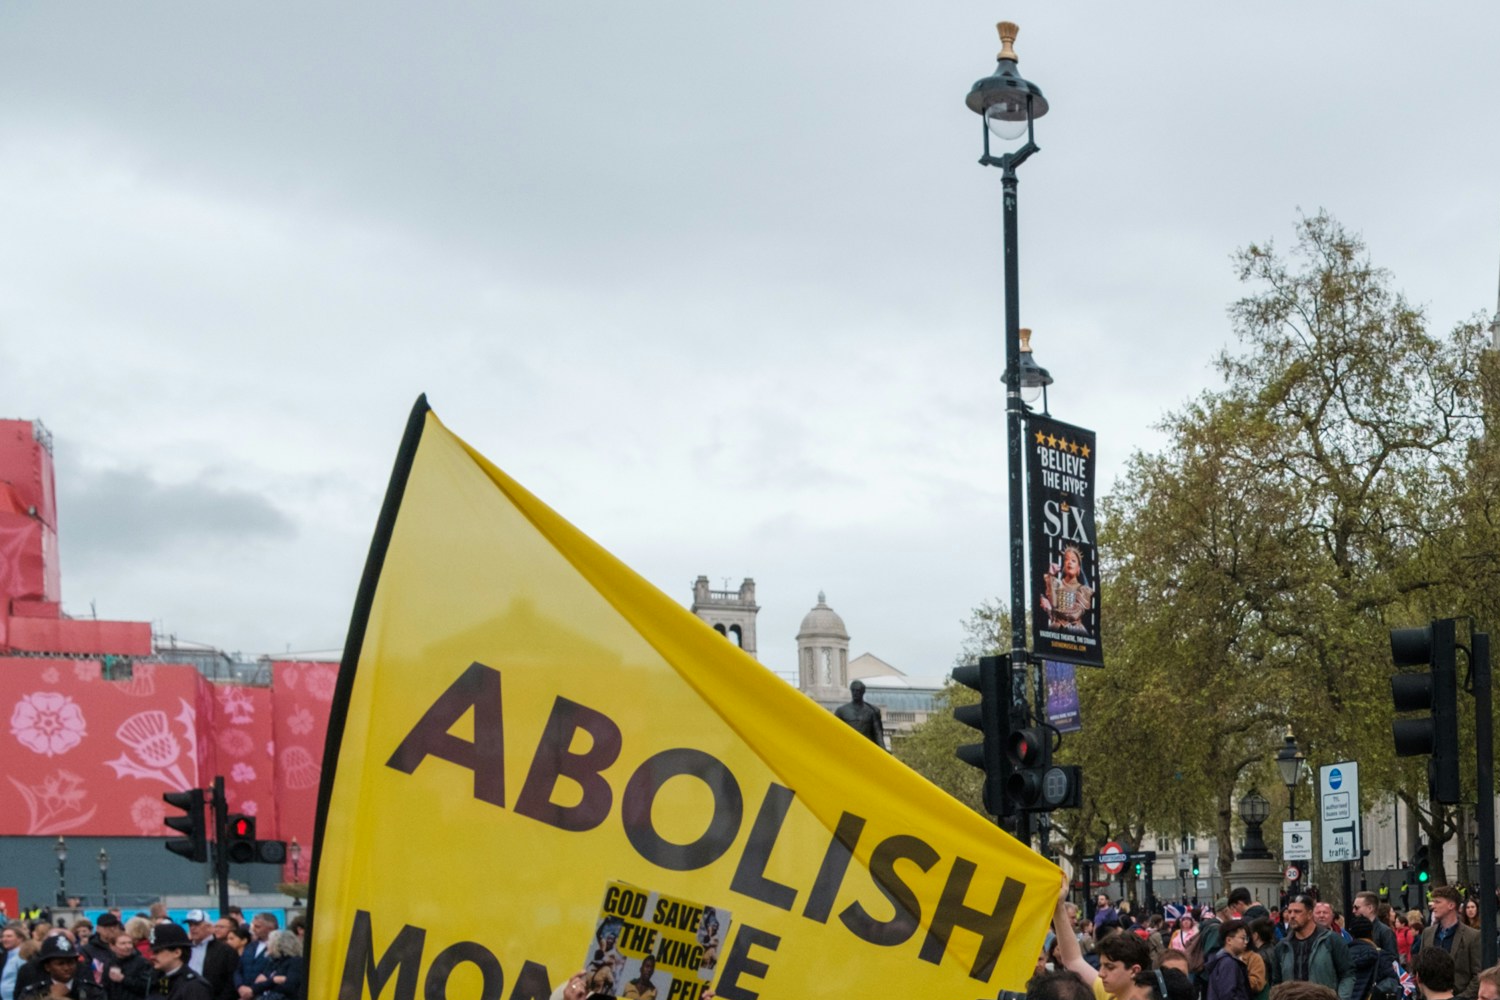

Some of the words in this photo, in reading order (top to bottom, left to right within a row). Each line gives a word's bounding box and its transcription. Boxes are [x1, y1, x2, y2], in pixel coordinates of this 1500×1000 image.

[1042, 469, 1060, 490] THE
[1044, 500, 1090, 544] SIX
[385, 661, 1027, 983] ABOLISH
[1329, 848, 1349, 857] traffic
[603, 886, 648, 919] GOD
[653, 898, 703, 934] SAVE
[619, 922, 658, 954] THE
[656, 937, 705, 972] KING
